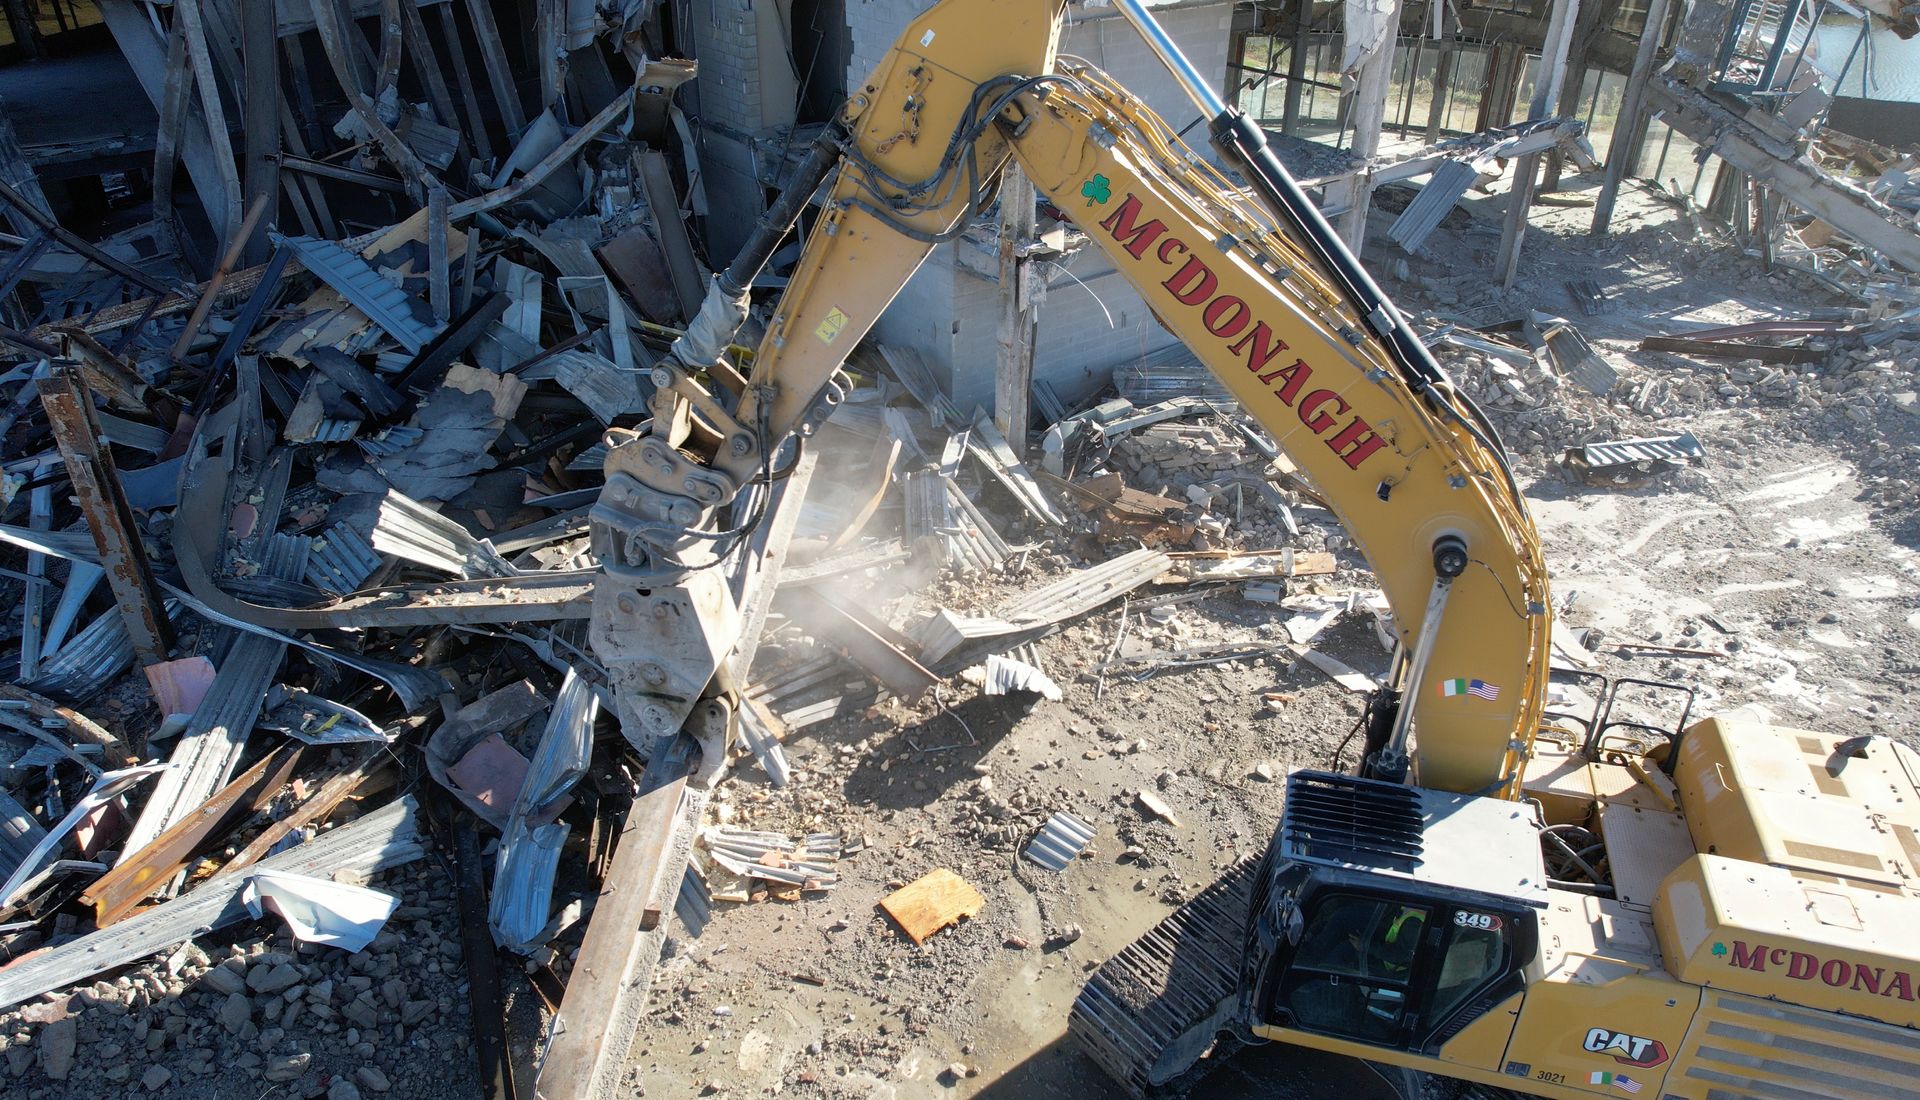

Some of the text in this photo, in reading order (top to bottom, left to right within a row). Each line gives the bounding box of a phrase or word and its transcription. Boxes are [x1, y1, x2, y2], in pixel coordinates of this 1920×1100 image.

[1099, 192, 1389, 471] McDONAGH
[1455, 910, 1492, 929] 349
[1728, 940, 1920, 1002] McDONA
[1584, 1028, 1653, 1061] CAT
[1537, 1070, 1566, 1084] 3021
